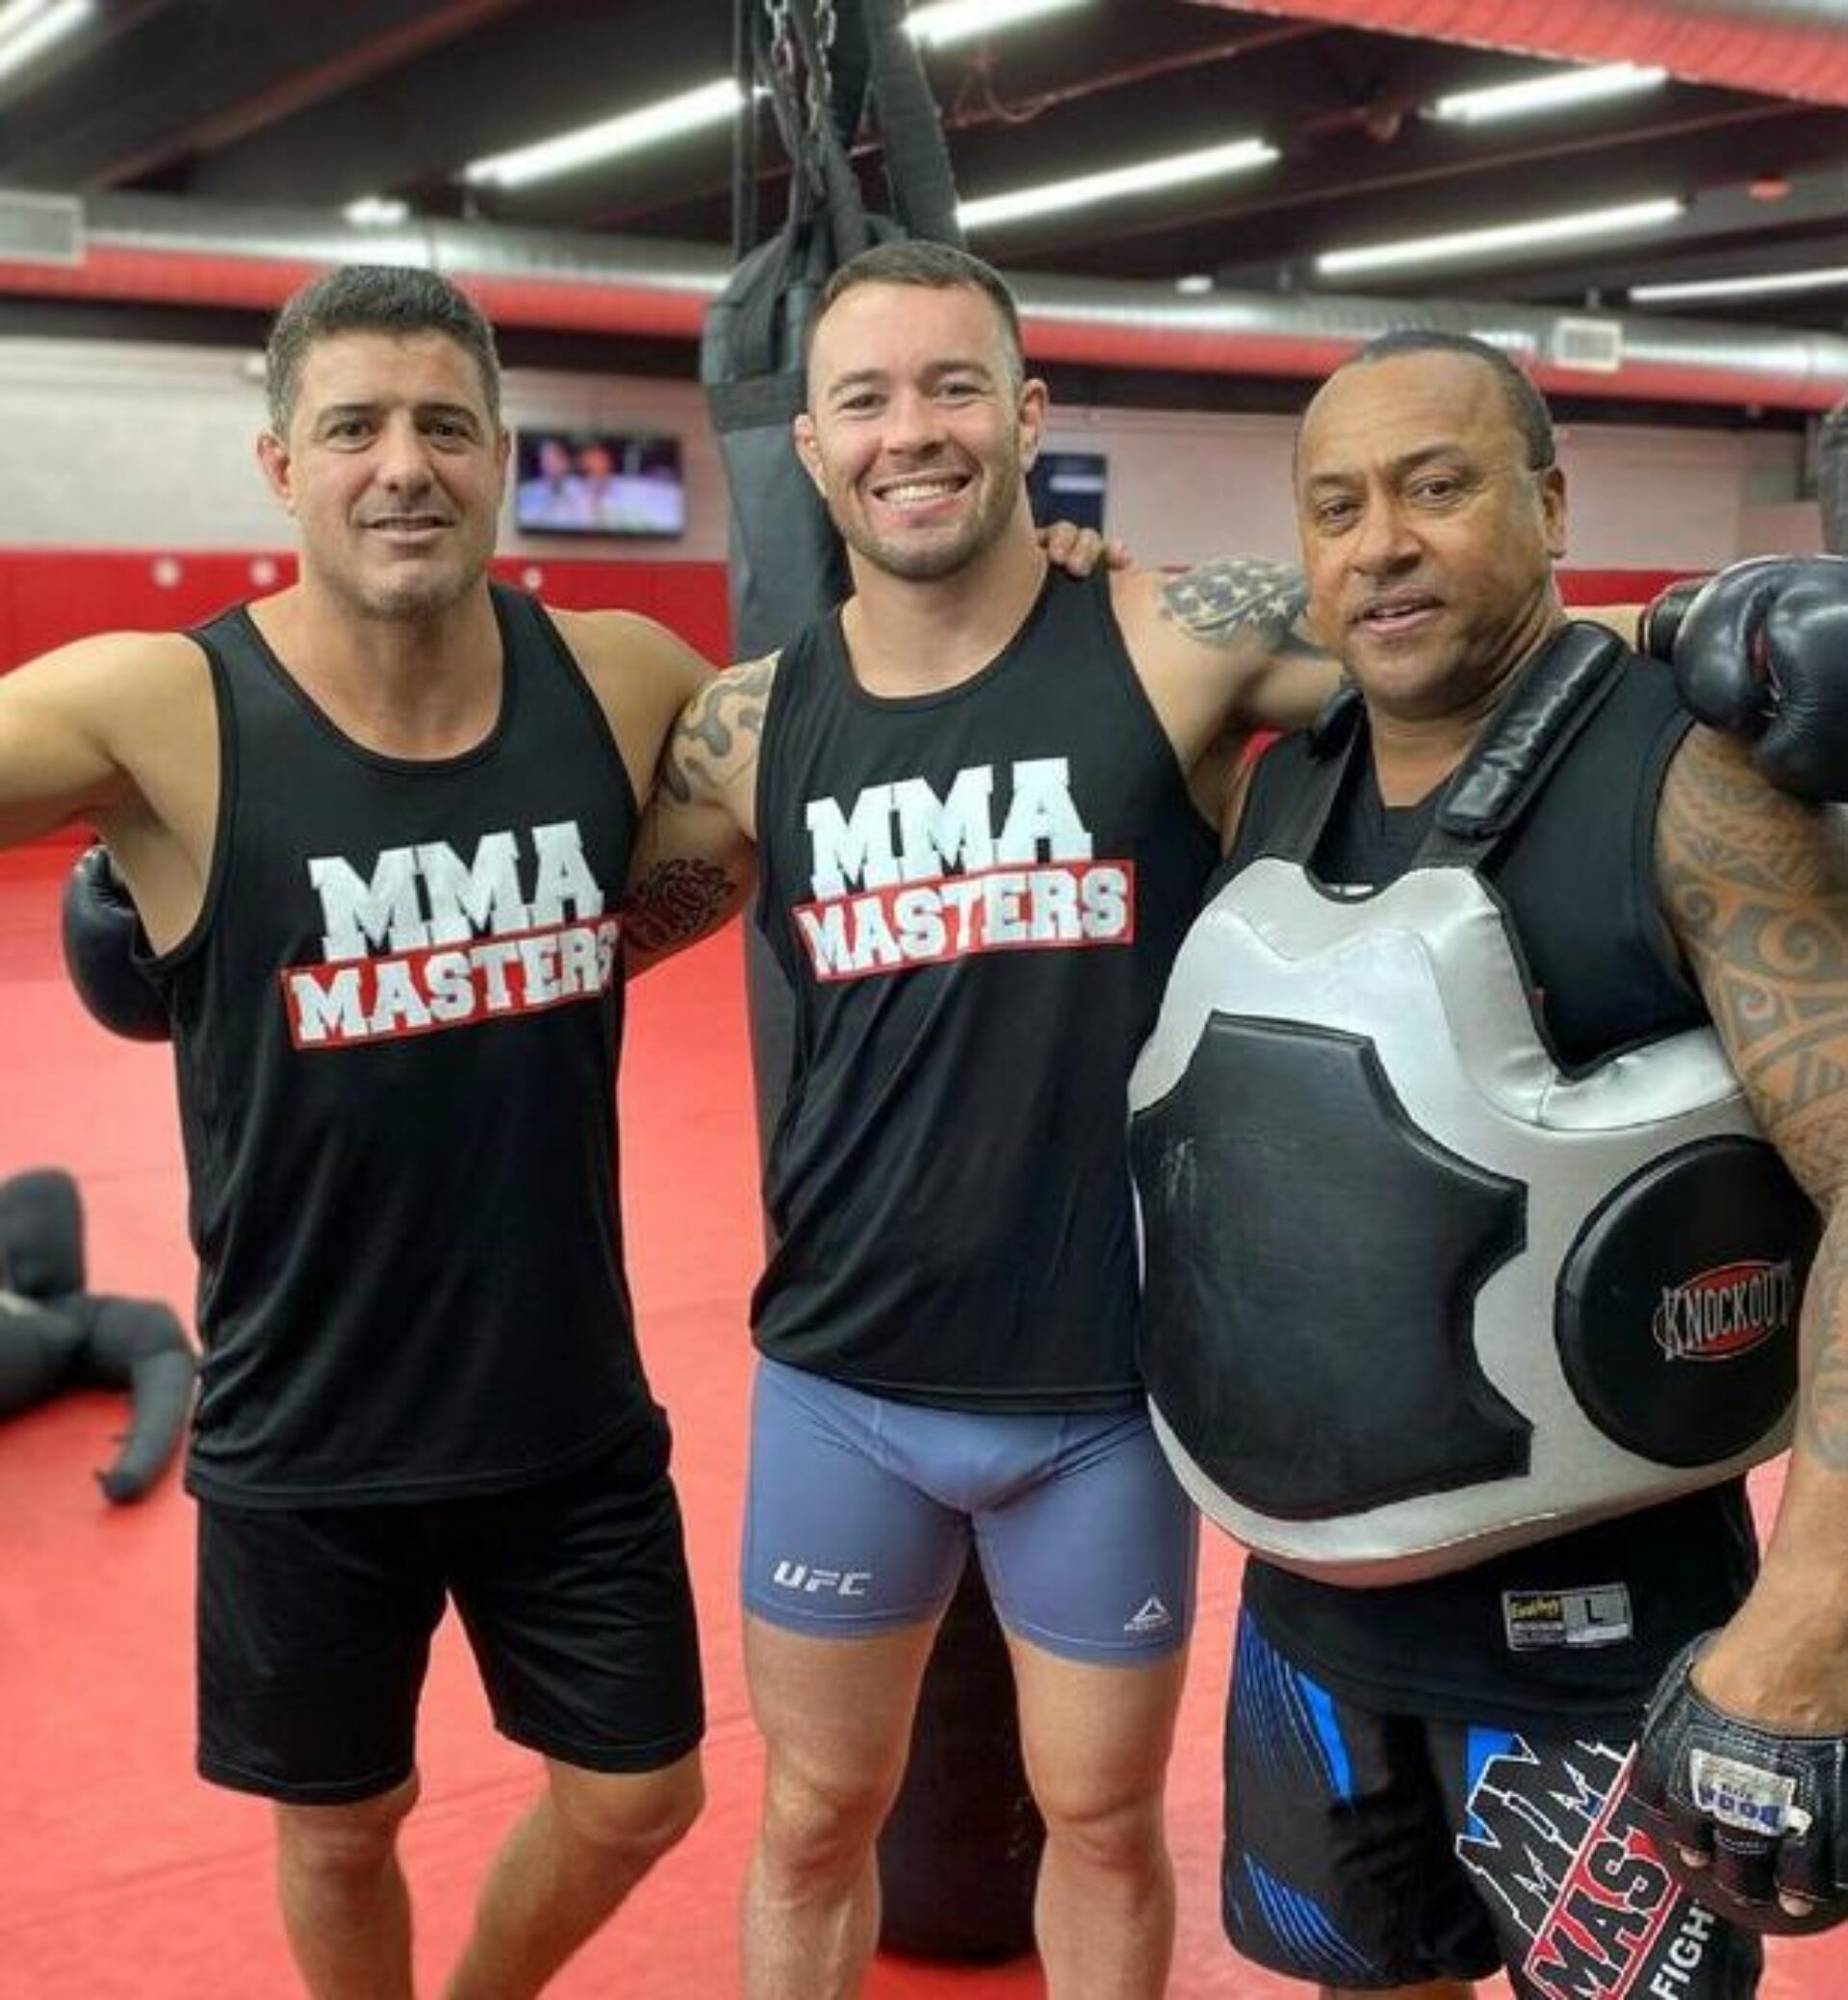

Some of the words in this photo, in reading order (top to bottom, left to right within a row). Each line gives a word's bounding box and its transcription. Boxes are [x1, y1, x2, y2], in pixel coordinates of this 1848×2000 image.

[806, 756, 1093, 901] MMA
[308, 819, 604, 962] MMA
[798, 866, 1130, 979] MASTERS
[290, 915, 617, 1041] MASTERS
[1661, 1261, 1793, 1362] KNOCKOUT
[772, 1560, 872, 1596] UFC
[1651, 1900, 1715, 2000] FIGH
